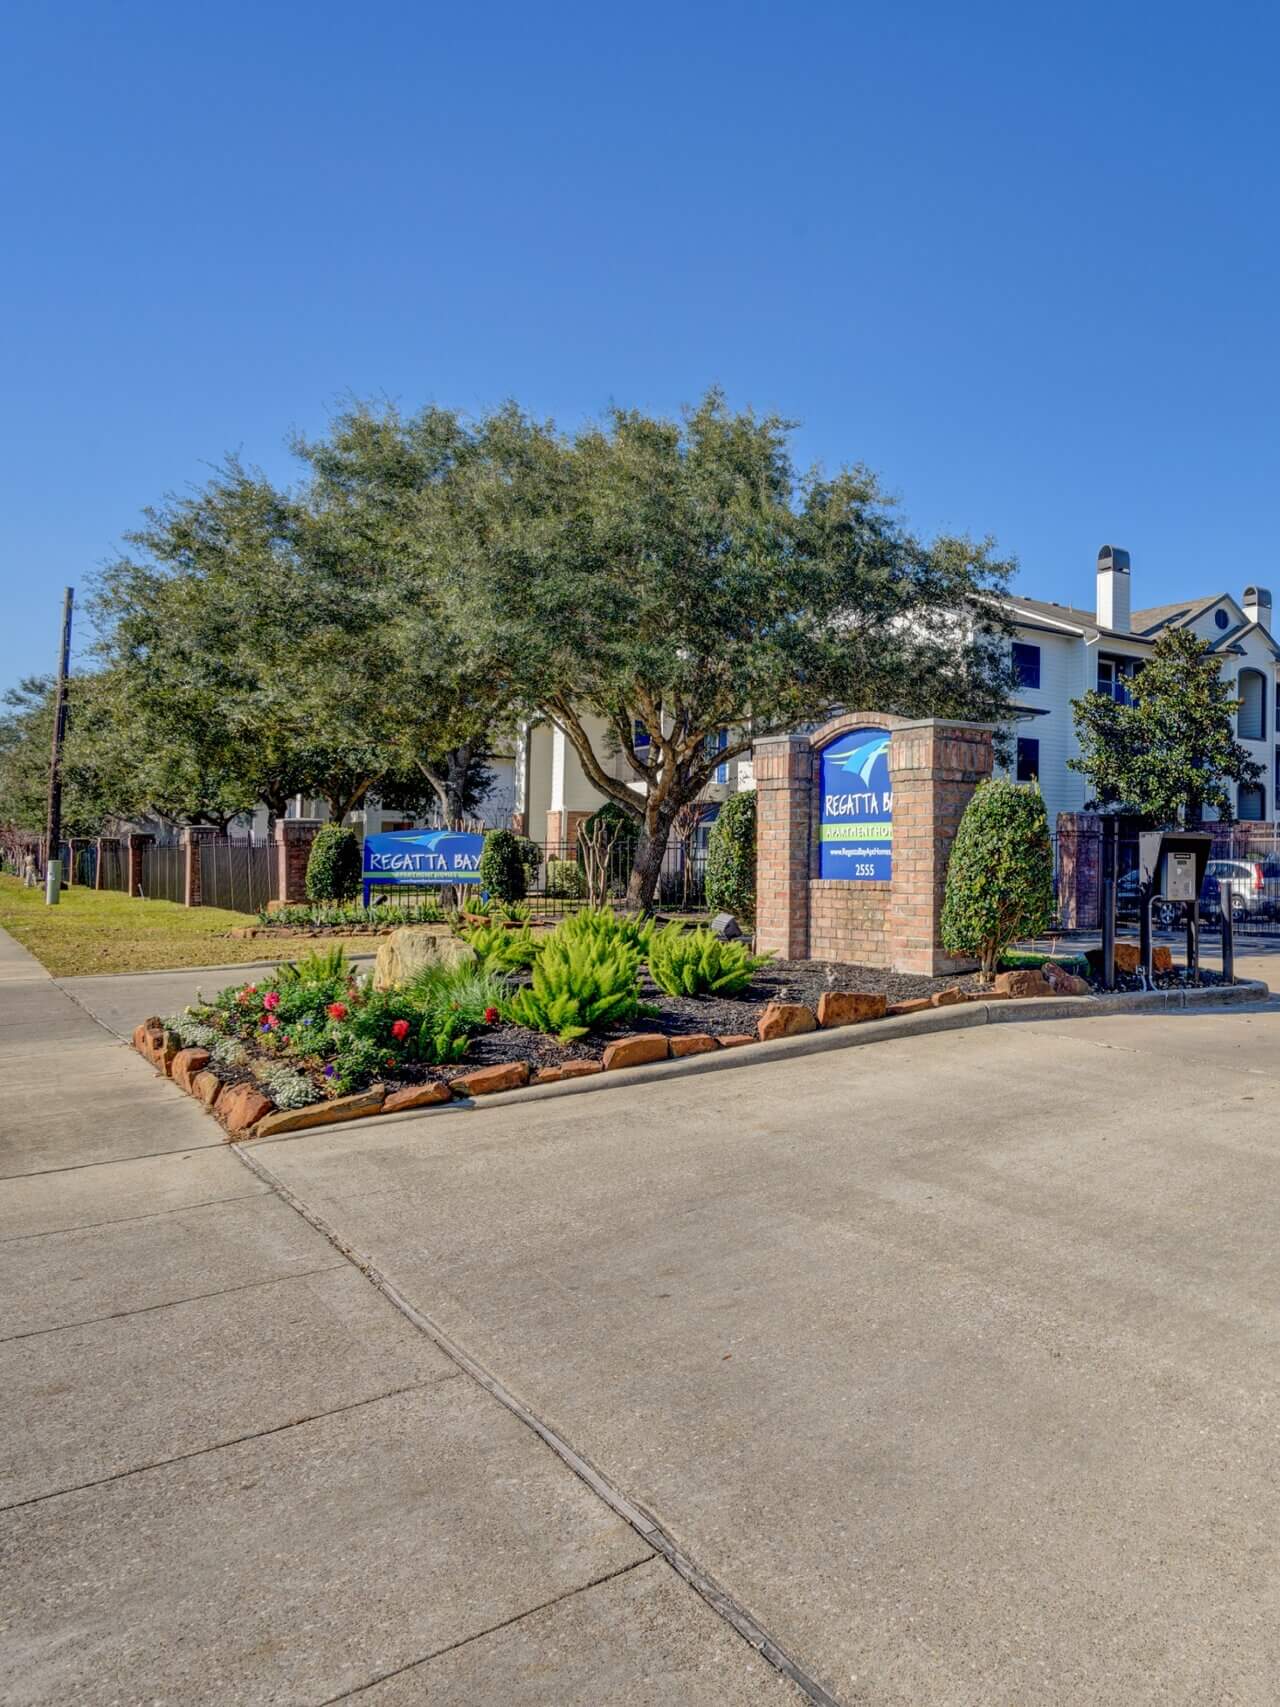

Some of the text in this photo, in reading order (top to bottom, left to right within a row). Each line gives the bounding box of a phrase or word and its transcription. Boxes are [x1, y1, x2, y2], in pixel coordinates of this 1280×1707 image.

[825, 792, 879, 816] REGATTA
[370, 853, 482, 870] REGATTA BAY
[855, 864, 875, 876] 2555
